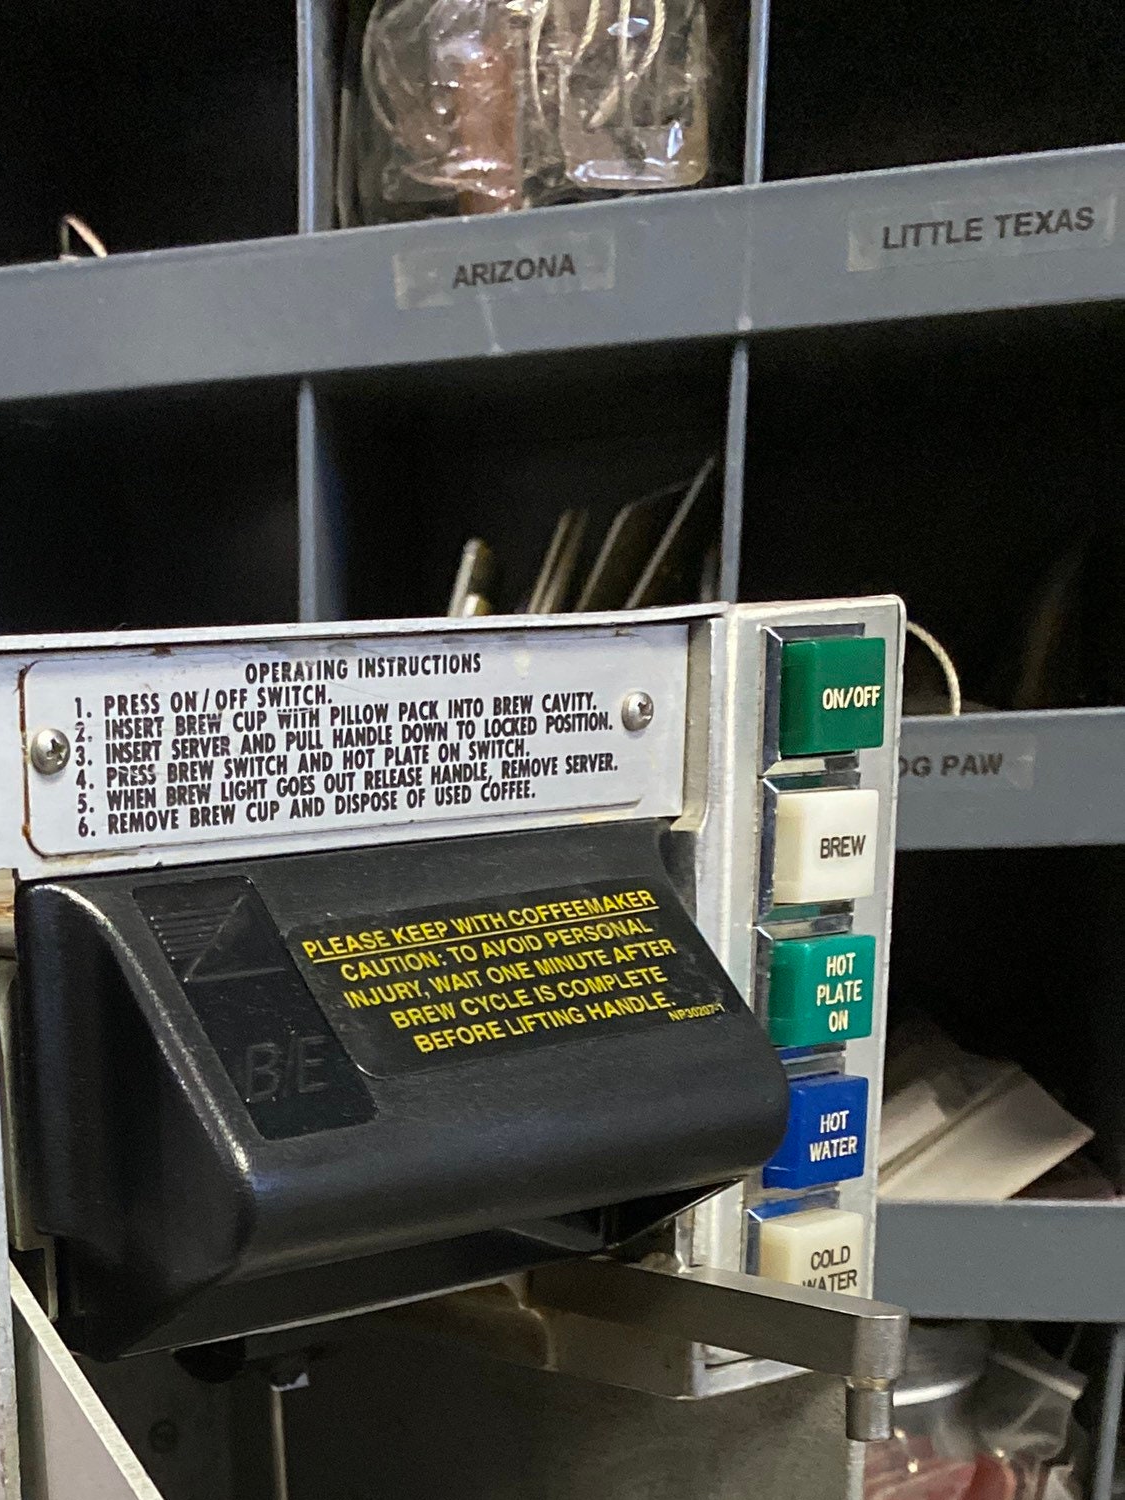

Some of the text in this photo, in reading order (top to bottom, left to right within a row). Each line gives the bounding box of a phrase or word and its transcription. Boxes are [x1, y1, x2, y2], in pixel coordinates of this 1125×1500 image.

[881, 205, 1096, 251] LITTLE TEXAS
[452, 253, 577, 290] ARIZONA
[245, 653, 481, 684] OPERATING INSTRUCTIONS
[74, 697, 92, 719] 1.
[104, 693, 160, 717] PRESS
[257, 684, 333, 708] SWITCH.
[822, 686, 881, 710] ON/OFF
[75, 691, 597, 743] 2. INSERT BREW CUP WITH PILLOW PACK INTO BREW CAVITY.
[75, 711, 614, 767] 3. INSERT SERVER AND PULL HANDLE DOWN TO LOCKED POSITION.
[76, 738, 531, 790] 4. PRESS BREW SWITCH AND HOT PLATE ON SWITCH.
[940, 753, 1003, 776] PAW
[77, 752, 619, 814] 5. WHEN BREW LIGHT GOES OUT RELEASE HANDLE, REMOVE SERVER.
[78, 779, 536, 837] 6. REMOVE BREW CUP AND DISPOSE OF USED COFFEE.
[820, 835, 866, 859] BREW
[301, 889, 656, 959] PLEASE KEEP WITH COFFEEMAKER
[340, 918, 654, 982] CAUTION: TO AVOID PERSONAL
[826, 952, 856, 978] HOT
[343, 938, 678, 1010] INJURY, WAIT ONE MINUTE AFTER
[815, 979, 863, 1006] PLATE
[390, 965, 669, 1029] BREW CYCLE IS COMPLETE
[413, 990, 677, 1053] BEFORE LIFTING HANDLE.
[828, 1009, 849, 1032] ON
[820, 1109, 850, 1134] HOT
[809, 1135, 858, 1163] WATER
[810, 1245, 851, 1271] COLD
